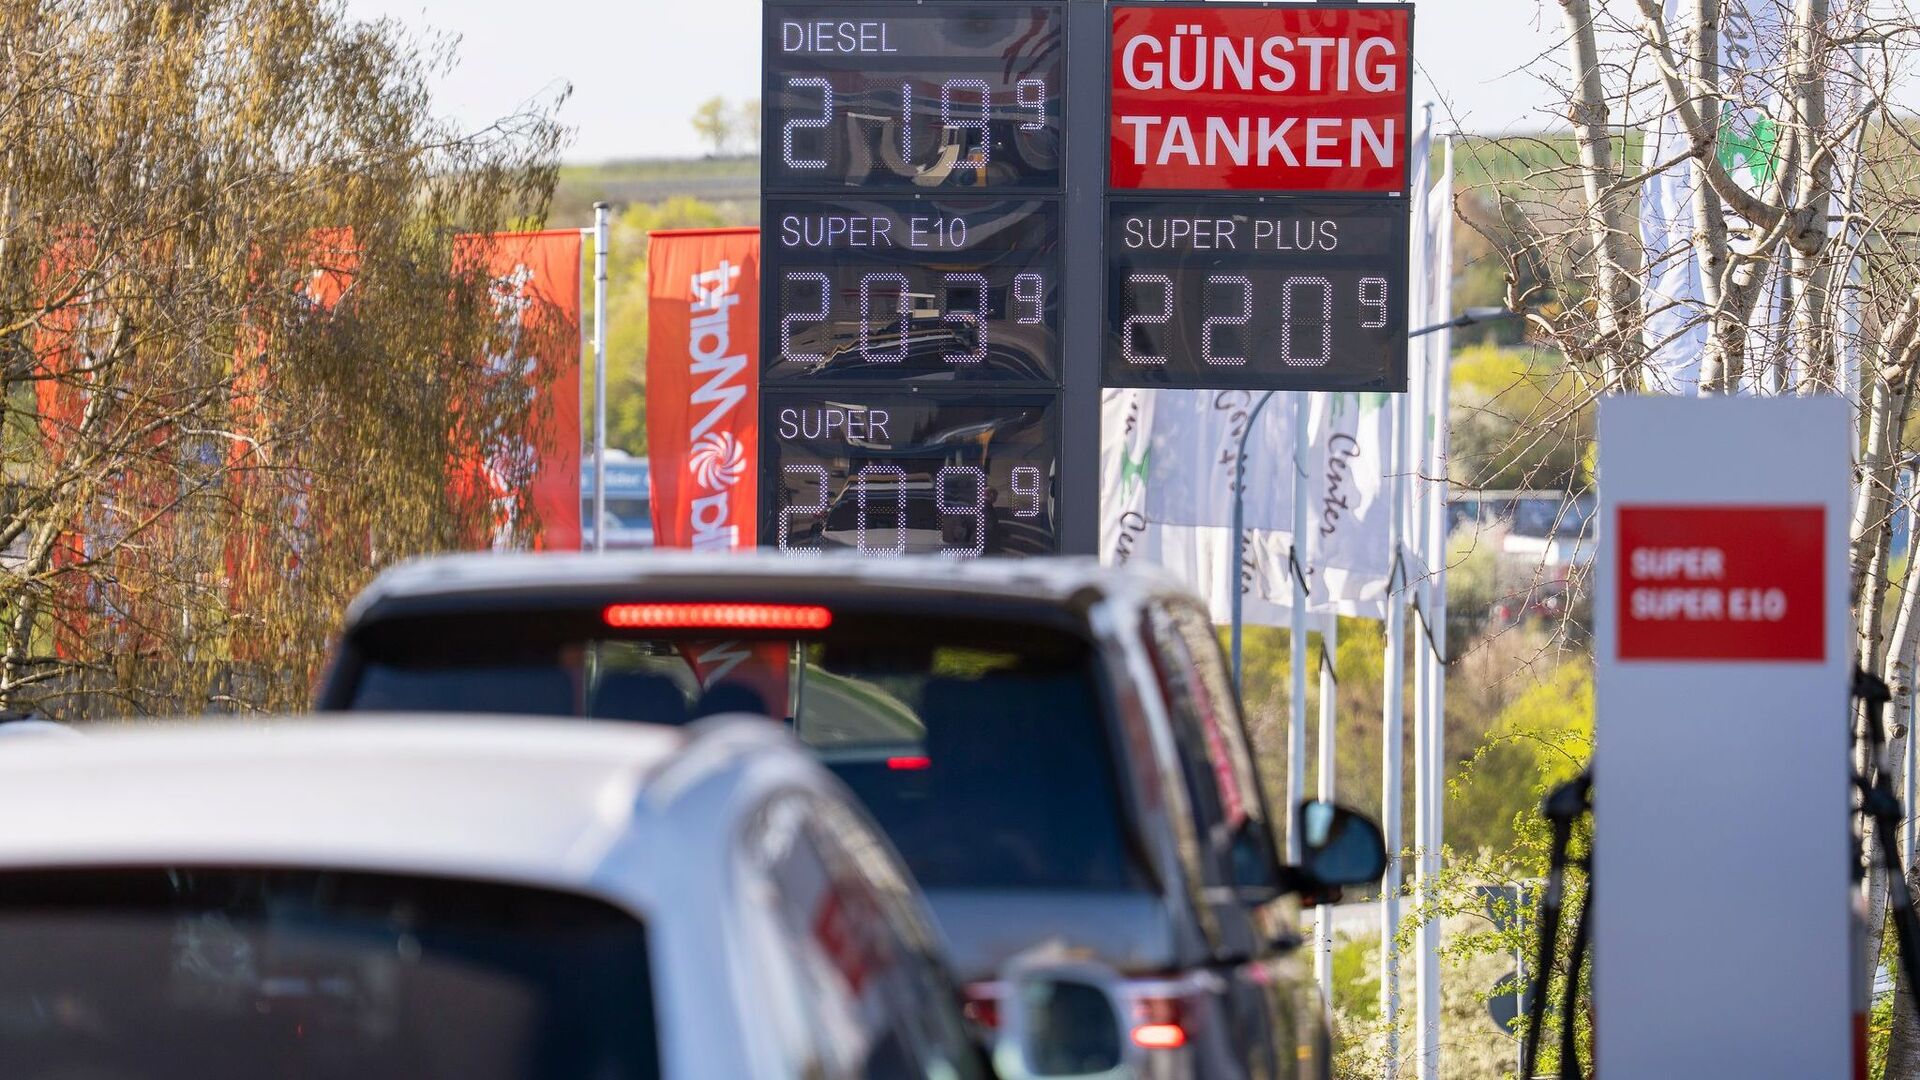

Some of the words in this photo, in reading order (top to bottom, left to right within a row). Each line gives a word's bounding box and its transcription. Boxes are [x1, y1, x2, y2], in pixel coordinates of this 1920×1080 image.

[783, 21, 898, 53] DIESEL
[1121, 25, 1397, 92] GÜNSTIG
[1121, 115, 1395, 168] TANKEN
[781, 216, 892, 248] SUPER
[911, 217, 967, 248] E10
[1124, 218, 1236, 250] SUPER
[1254, 219, 1338, 252] PLUS
[778, 408, 890, 440] SUPER
[1320, 432, 1360, 538] Center
[1631, 547, 1724, 580] SUPER
[1631, 588, 1724, 621] SUPER
[1727, 588, 1787, 621] E10
